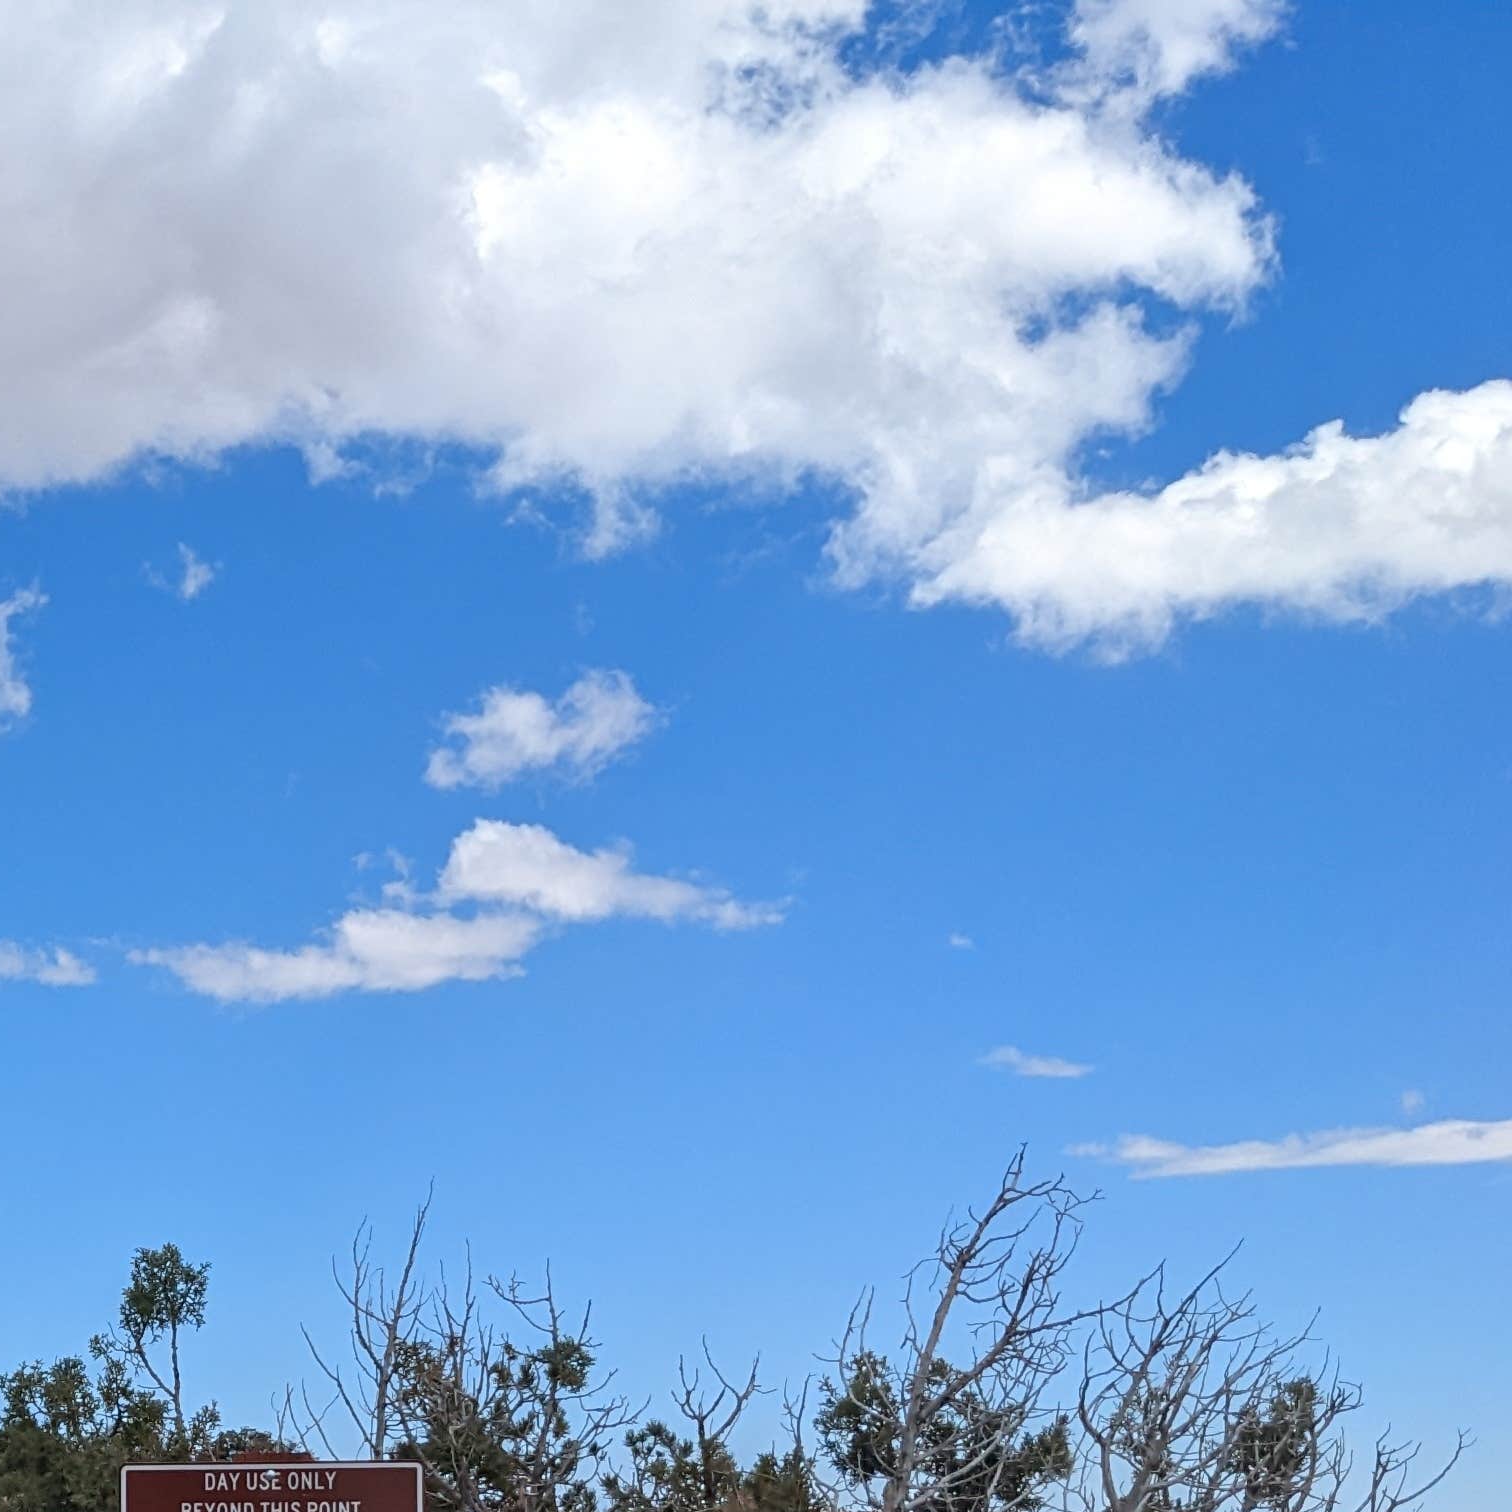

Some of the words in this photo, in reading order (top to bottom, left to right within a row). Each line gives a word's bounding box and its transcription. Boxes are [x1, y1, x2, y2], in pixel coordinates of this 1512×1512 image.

[204, 1472, 238, 1491] DAY
[246, 1471, 281, 1491] USE
[287, 1471, 337, 1490] ONLY
